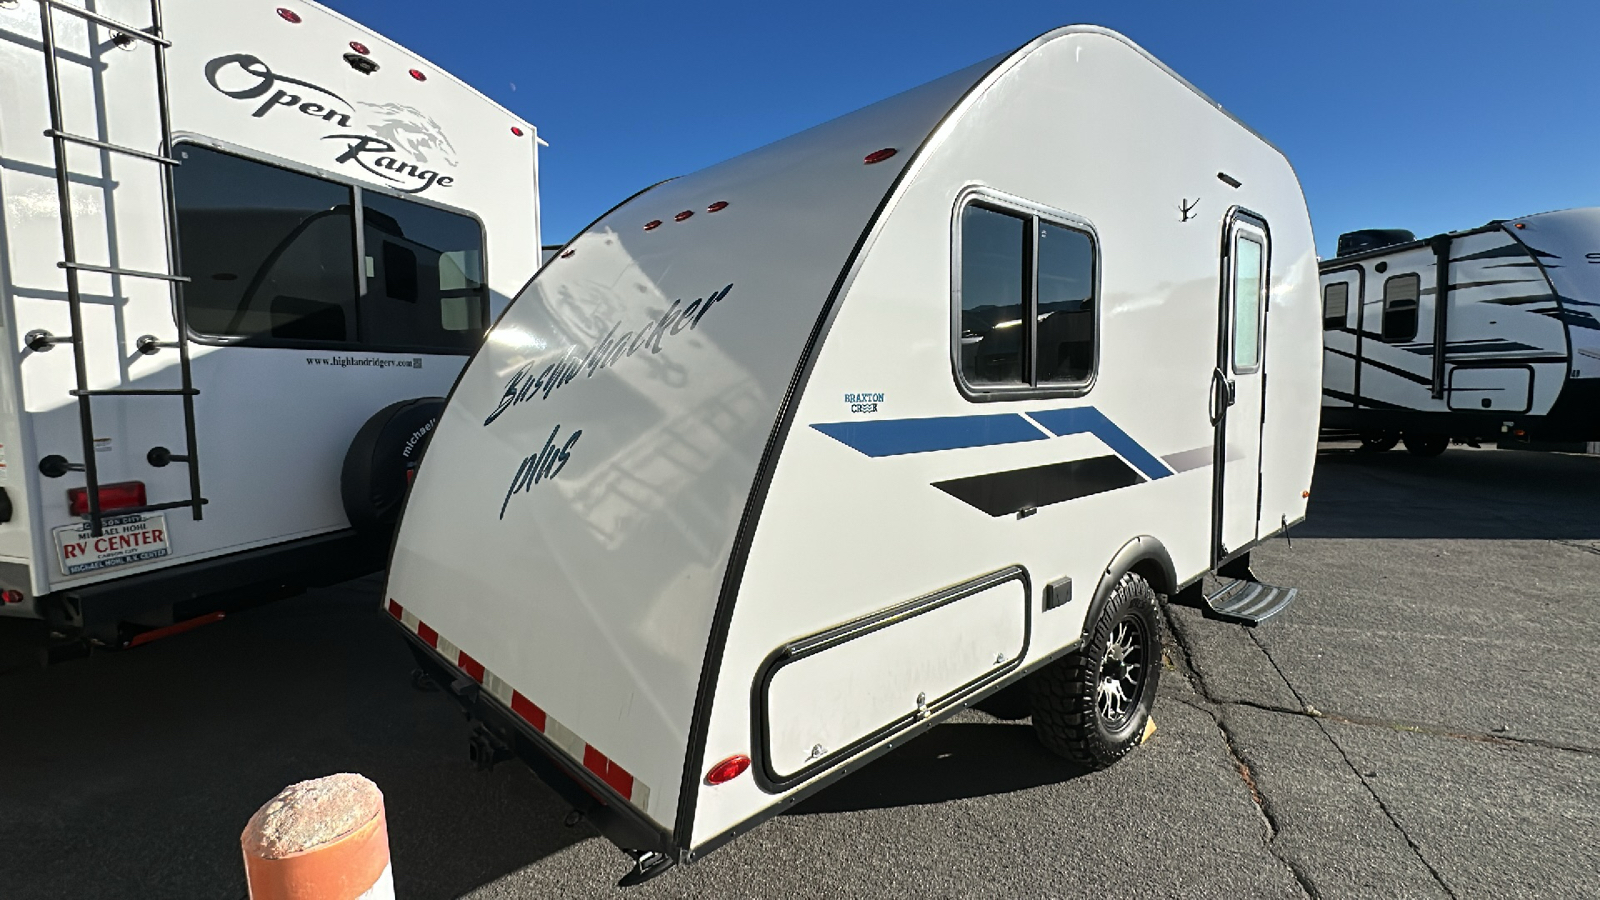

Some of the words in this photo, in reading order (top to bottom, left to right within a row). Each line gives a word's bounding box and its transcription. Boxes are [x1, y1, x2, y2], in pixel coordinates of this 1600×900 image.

[205, 53, 356, 127] Open
[320, 134, 454, 193] Range
[306, 357, 413, 368] www.highlandridgerv.com
[844, 393, 884, 403] BRAXTON
[500, 424, 583, 520] plus
[84, 519, 120, 529] CSON
[64, 541, 88, 559] RV
[94, 529, 163, 553] CENTER
